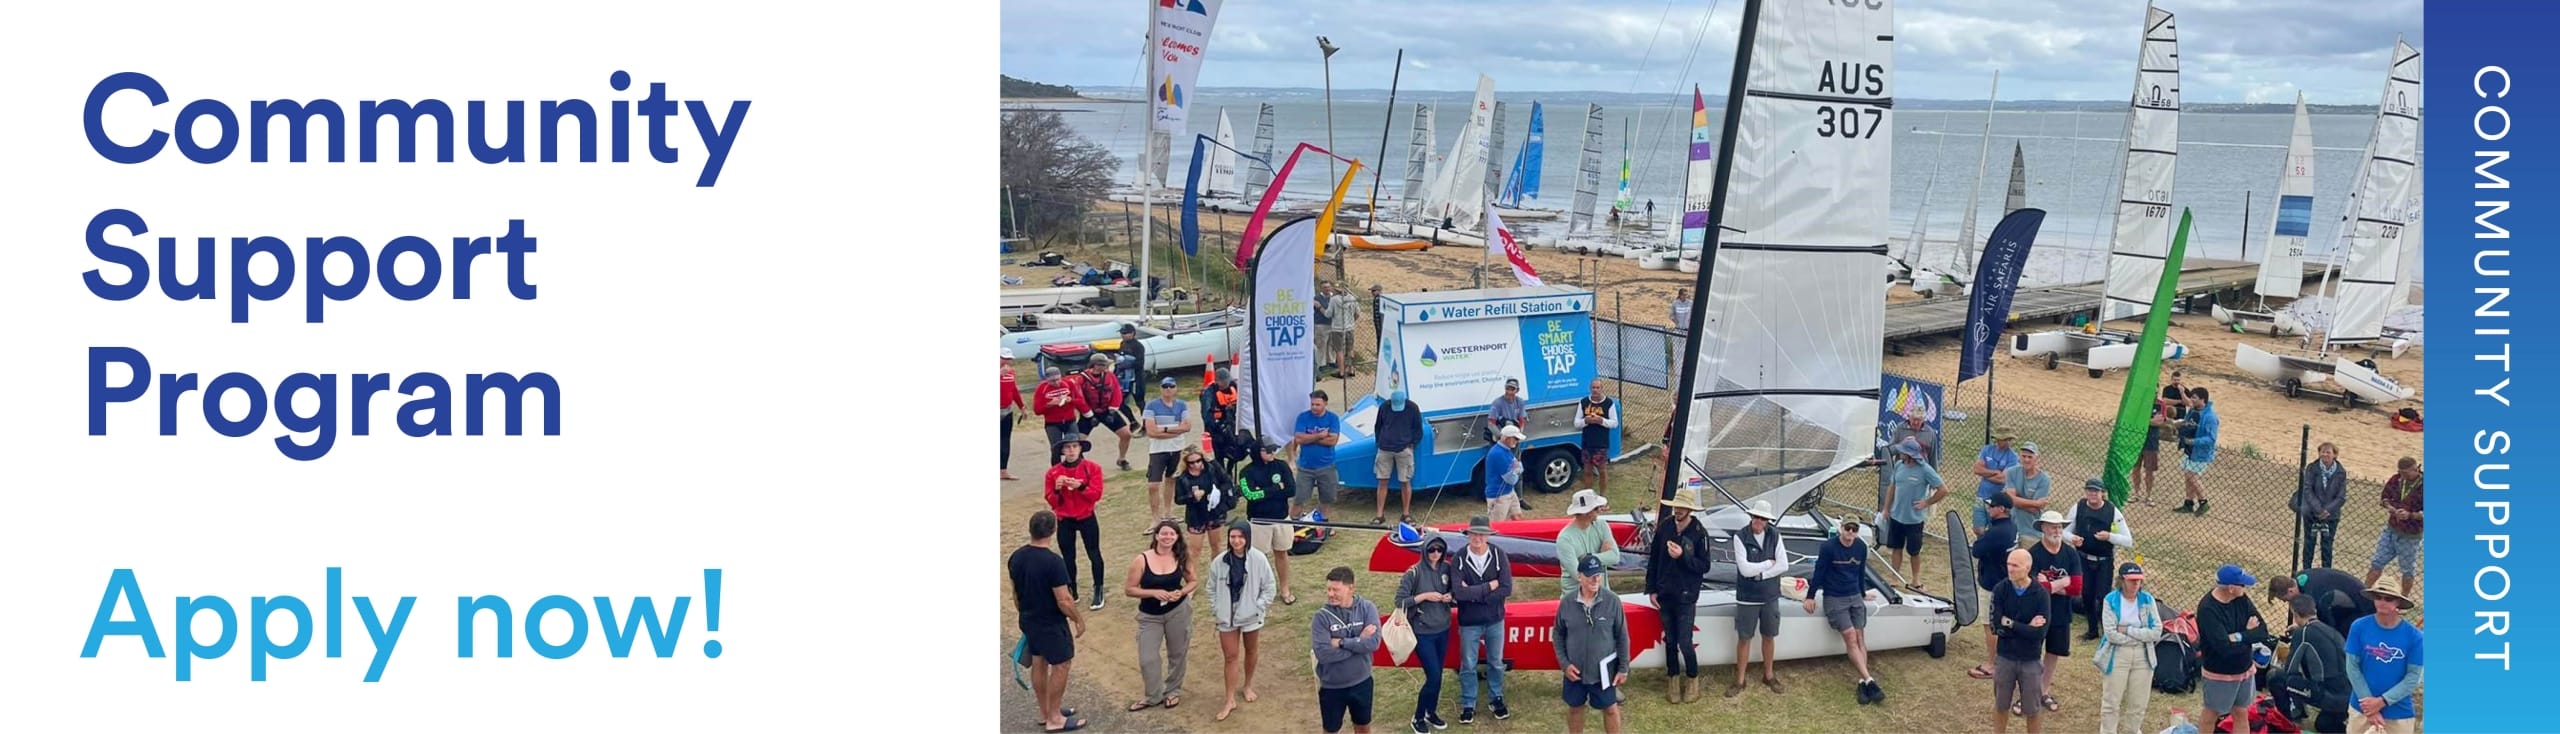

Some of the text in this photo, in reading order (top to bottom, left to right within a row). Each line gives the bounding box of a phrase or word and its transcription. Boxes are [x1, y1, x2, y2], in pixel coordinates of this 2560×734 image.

[1818, 60, 1884, 95] AUS
[1817, 106, 1882, 139] 307
[2145, 206, 2166, 218] 1670
[1984, 293, 1999, 315] AIR
[1993, 240, 2017, 290] SAFARIS
[1277, 288, 1294, 302] BE
[1264, 302, 1307, 315] SMART
[1442, 301, 1562, 318] Water Refill Station
[1265, 315, 1306, 326] CHOOSE
[1547, 320, 1562, 332] BE
[1266, 326, 1306, 347] TAP
[1538, 331, 1574, 345] SMART
[1441, 343, 1508, 354] WESTERNPORT
[1541, 344, 1575, 356] CHOOSE
[1442, 353, 1470, 361] WATER
[1543, 353, 1576, 375] TAP
[1509, 626, 1554, 643] RPI
